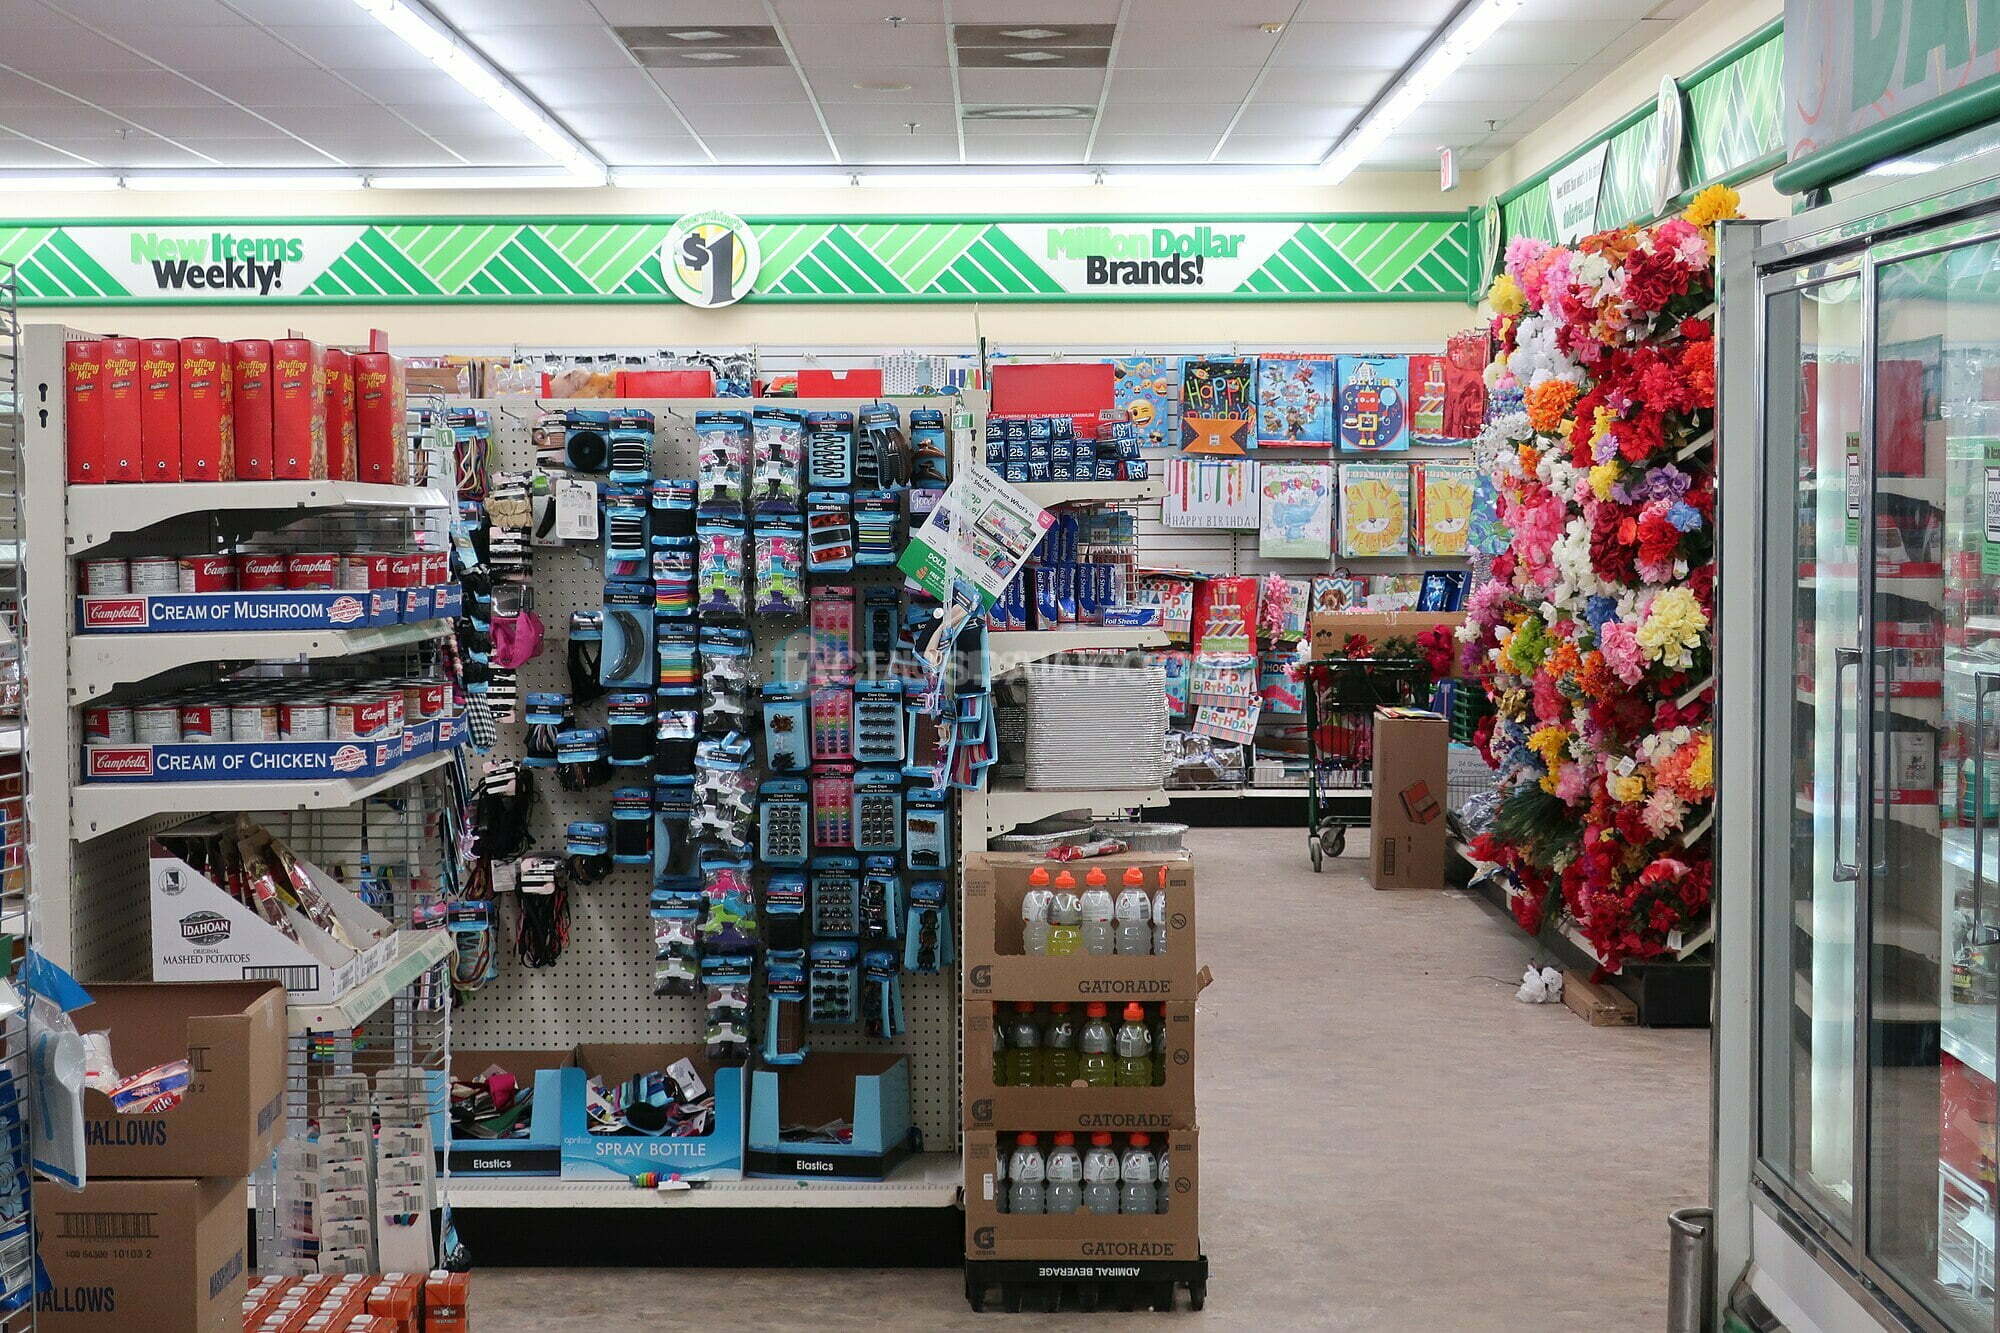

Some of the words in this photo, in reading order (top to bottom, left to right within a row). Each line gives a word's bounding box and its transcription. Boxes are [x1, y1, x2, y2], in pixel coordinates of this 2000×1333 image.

[130, 233, 208, 264] New
[212, 233, 303, 262] Items
[1047, 227, 1149, 259] Million
[1152, 227, 1246, 258] Dollar
[683, 230, 736, 305] $1
[1087, 253, 1204, 285] Brands!
[152, 257, 282, 296] Weekly!
[68, 362, 99, 374] Stuffing
[105, 359, 137, 370] Stuffing
[144, 360, 175, 372] Stuffing
[184, 359, 216, 371] Stuffing
[237, 360, 267, 371] Stuffing
[276, 360, 307, 372] Stuffing
[77, 370, 92, 380] Mix
[114, 368, 128, 377] Mix
[152, 369, 167, 378] Mix
[192, 367, 208, 377] Mix
[245, 368, 259, 378] Mix
[285, 368, 300, 378] Mix
[358, 372, 386, 384] Stuffing
[367, 380, 380, 389] Mix
[987, 427, 1001, 436] 25
[1009, 427, 1022, 437] 25
[1009, 447, 1023, 457] 25
[1053, 447, 1067, 456] 25
[1076, 446, 1091, 456] 25
[1007, 470, 1021, 479] 25
[1053, 468, 1067, 478] 25
[1076, 468, 1090, 477] 25
[1098, 467, 1112, 477] 25
[983, 475, 997, 490] More
[998, 488, 1010, 500] than
[1010, 497, 1028, 514] What's
[1172, 515, 1203, 526] HAPPY
[1206, 516, 1257, 527] BIRTHDAY
[1139, 590, 1189, 608] HAPPY
[91, 604, 141, 622] Campbell's
[152, 602, 207, 620] CREAM
[211, 604, 231, 619] OF
[234, 601, 323, 620] MUSHROOM
[1194, 680, 1247, 695] BIRTHDAY
[1200, 710, 1253, 733] BIRTHDAY
[96, 754, 146, 771] Campbell's
[157, 753, 215, 770] CREAM
[222, 754, 245, 769] OF
[250, 751, 326, 769] CHICKEN
[183, 920, 230, 937] IDAHOAN
[163, 954, 203, 965] MASHED
[206, 953, 250, 964] POTATOES
[1078, 980, 1171, 994] GATORADE
[1078, 1114, 1172, 1128] GATORADE
[595, 1142, 643, 1157] SPRAY
[650, 1143, 706, 1156] BOTTLE
[473, 1158, 512, 1170] Elastics
[796, 1159, 834, 1172] Elastics
[1081, 1242, 1175, 1257] GATORADE
[1039, 1266, 1093, 1277] BEVERAGE
[1095, 1266, 1141, 1277] ADMIRAL
